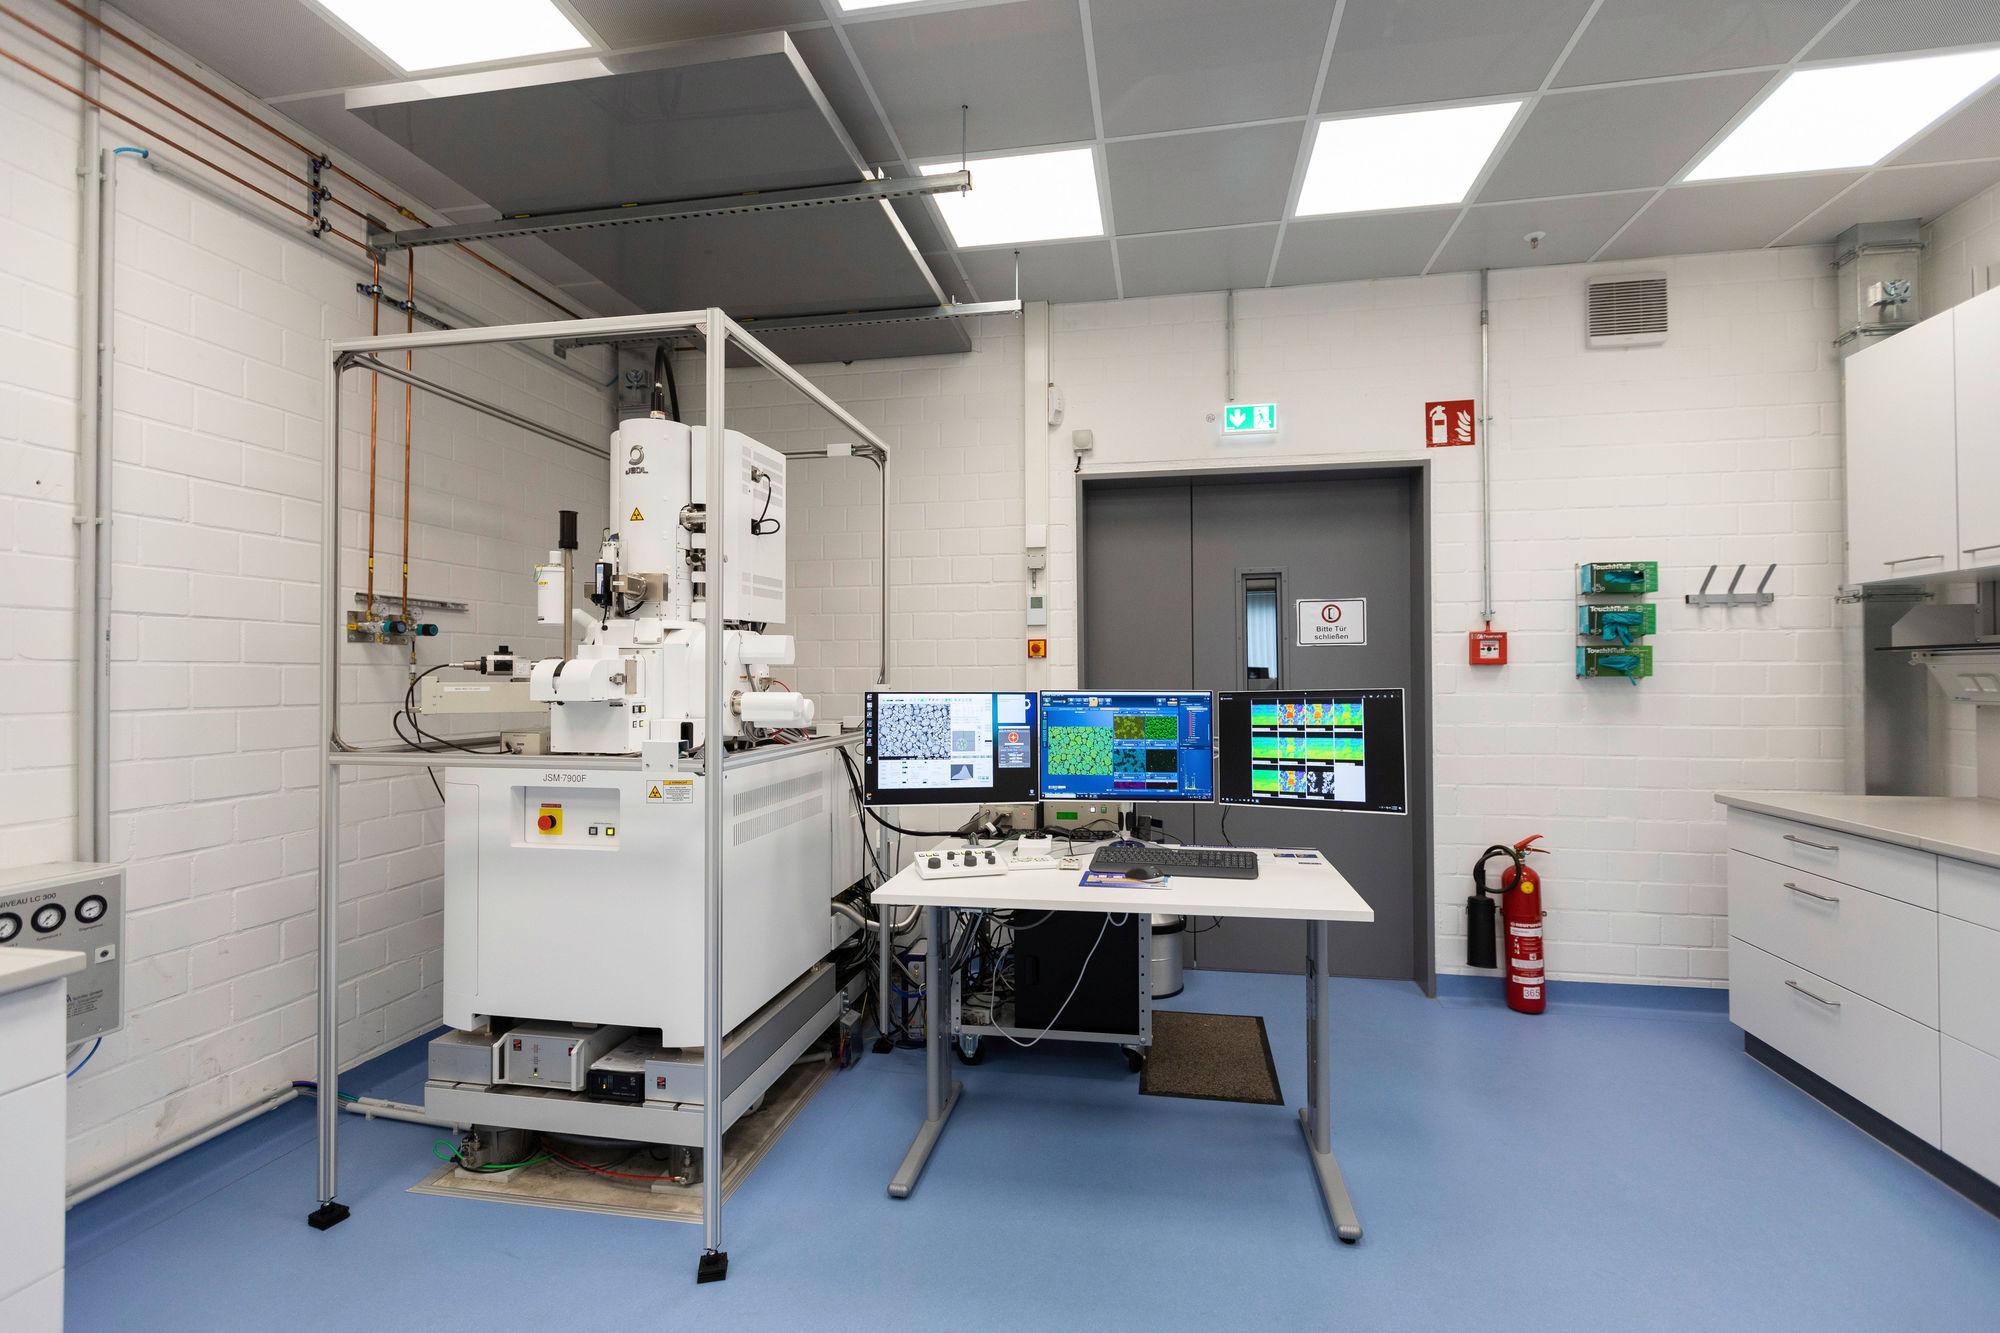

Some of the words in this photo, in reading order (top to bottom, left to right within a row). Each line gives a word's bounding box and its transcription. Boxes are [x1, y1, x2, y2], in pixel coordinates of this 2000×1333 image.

[625, 467, 649, 475] JEOL
[543, 773, 587, 783] JSM-7900F
[30, 895, 41, 903] LC
[43, 892, 57, 901] 300
[1524, 988, 1540, 998] 365
